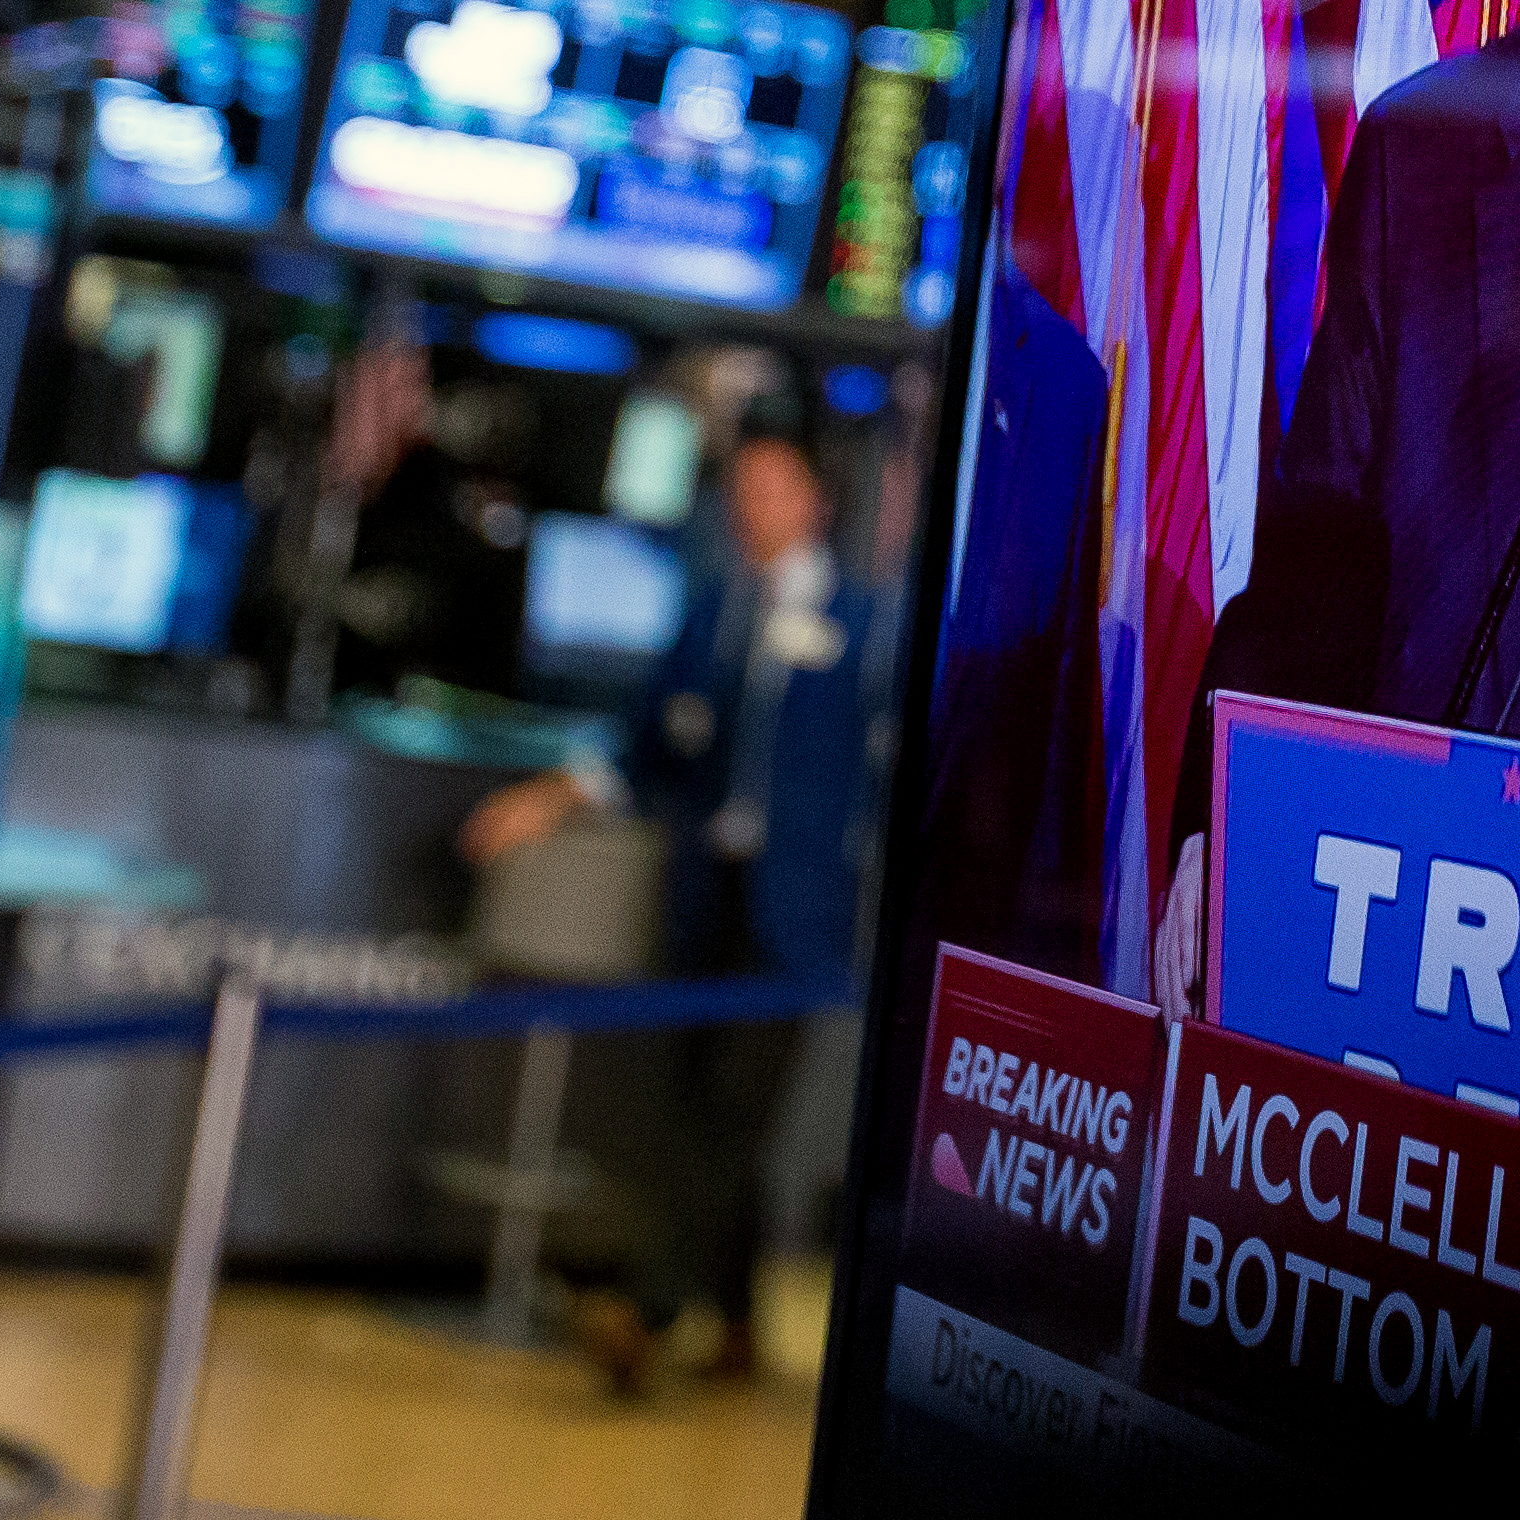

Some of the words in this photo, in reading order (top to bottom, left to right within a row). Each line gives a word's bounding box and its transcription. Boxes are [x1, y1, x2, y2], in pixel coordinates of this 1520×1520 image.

[942, 1034, 1135, 1156] BREAKING
[974, 1126, 1120, 1250] NEWS
[1175, 1215, 1493, 1437] BOTTOM
